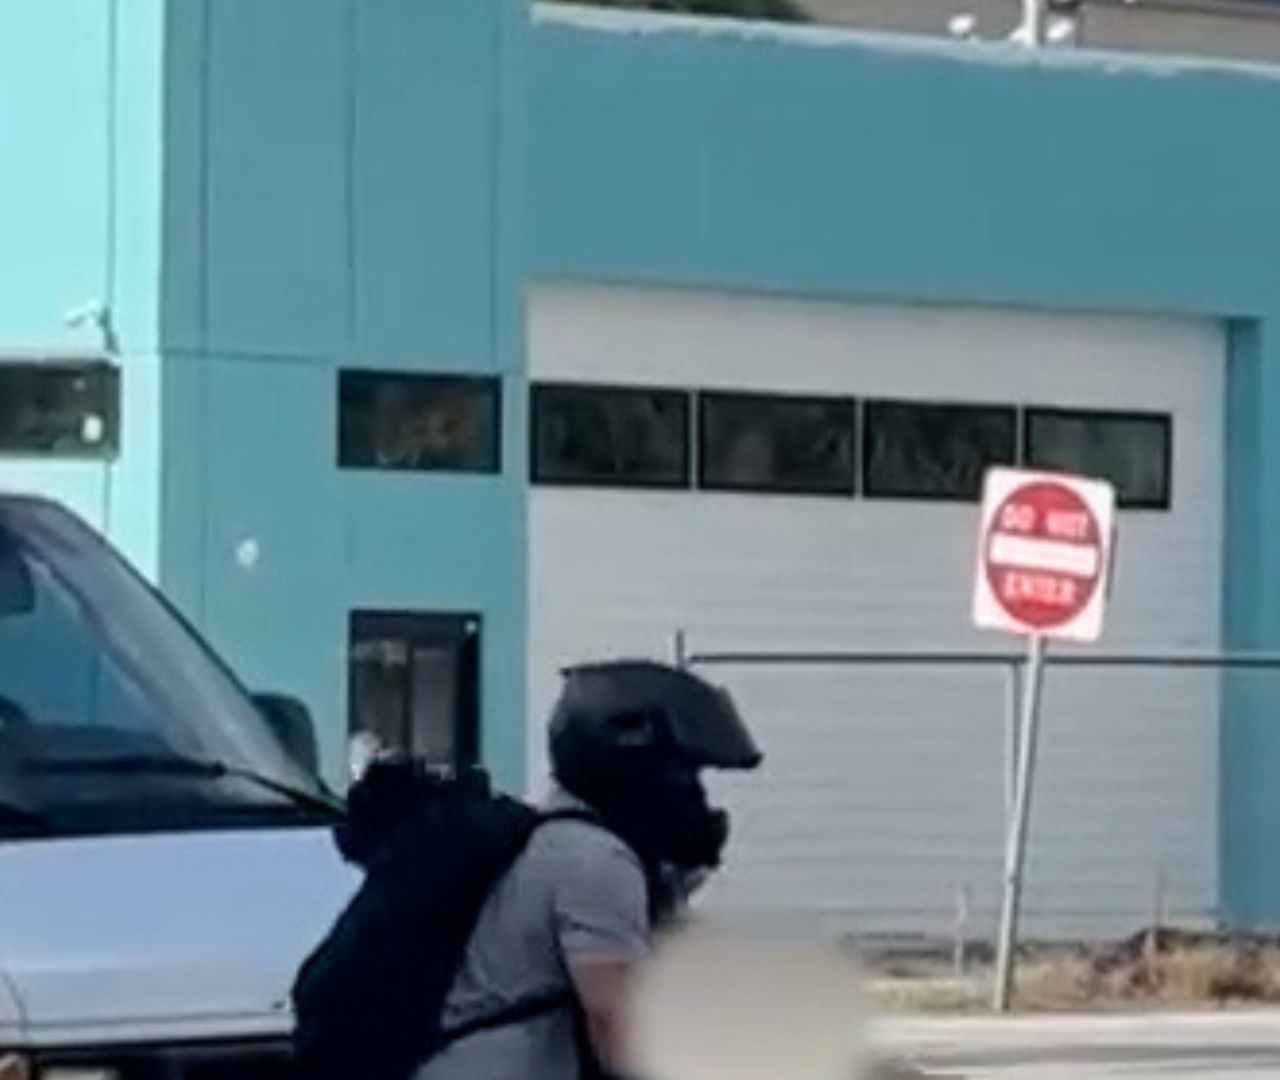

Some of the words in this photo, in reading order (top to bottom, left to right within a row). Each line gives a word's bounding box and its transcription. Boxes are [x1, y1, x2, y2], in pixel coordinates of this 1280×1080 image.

[1002, 503, 1035, 530] DO
[1046, 510, 1089, 538] NOT
[1004, 572, 1077, 605] ENTER
